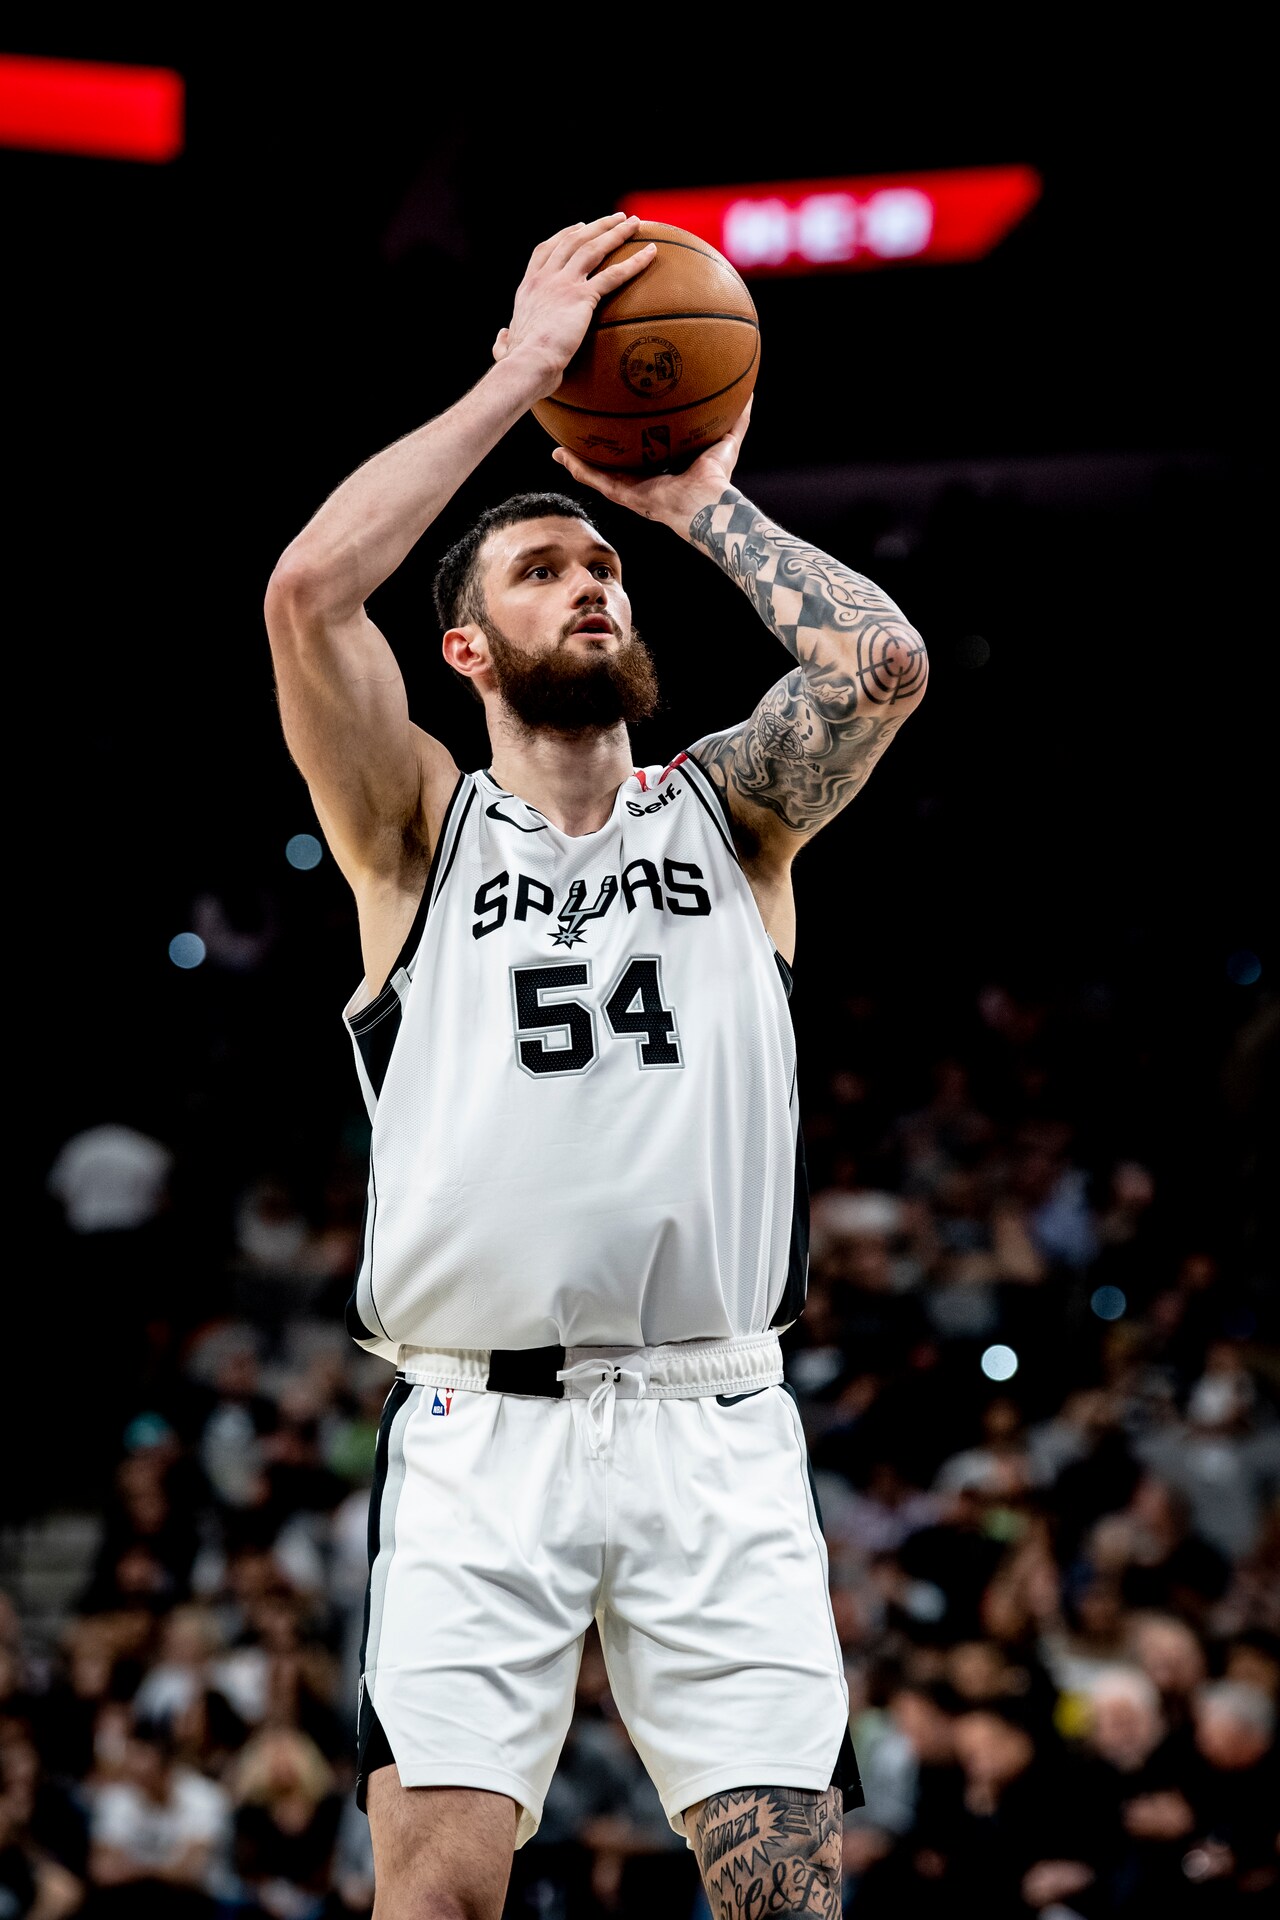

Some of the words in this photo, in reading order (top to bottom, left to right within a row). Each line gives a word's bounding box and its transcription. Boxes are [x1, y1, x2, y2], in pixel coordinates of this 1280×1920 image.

[626, 783, 682, 817] Self.
[472, 858, 712, 949] SPURS
[509, 955, 685, 1079] 54
